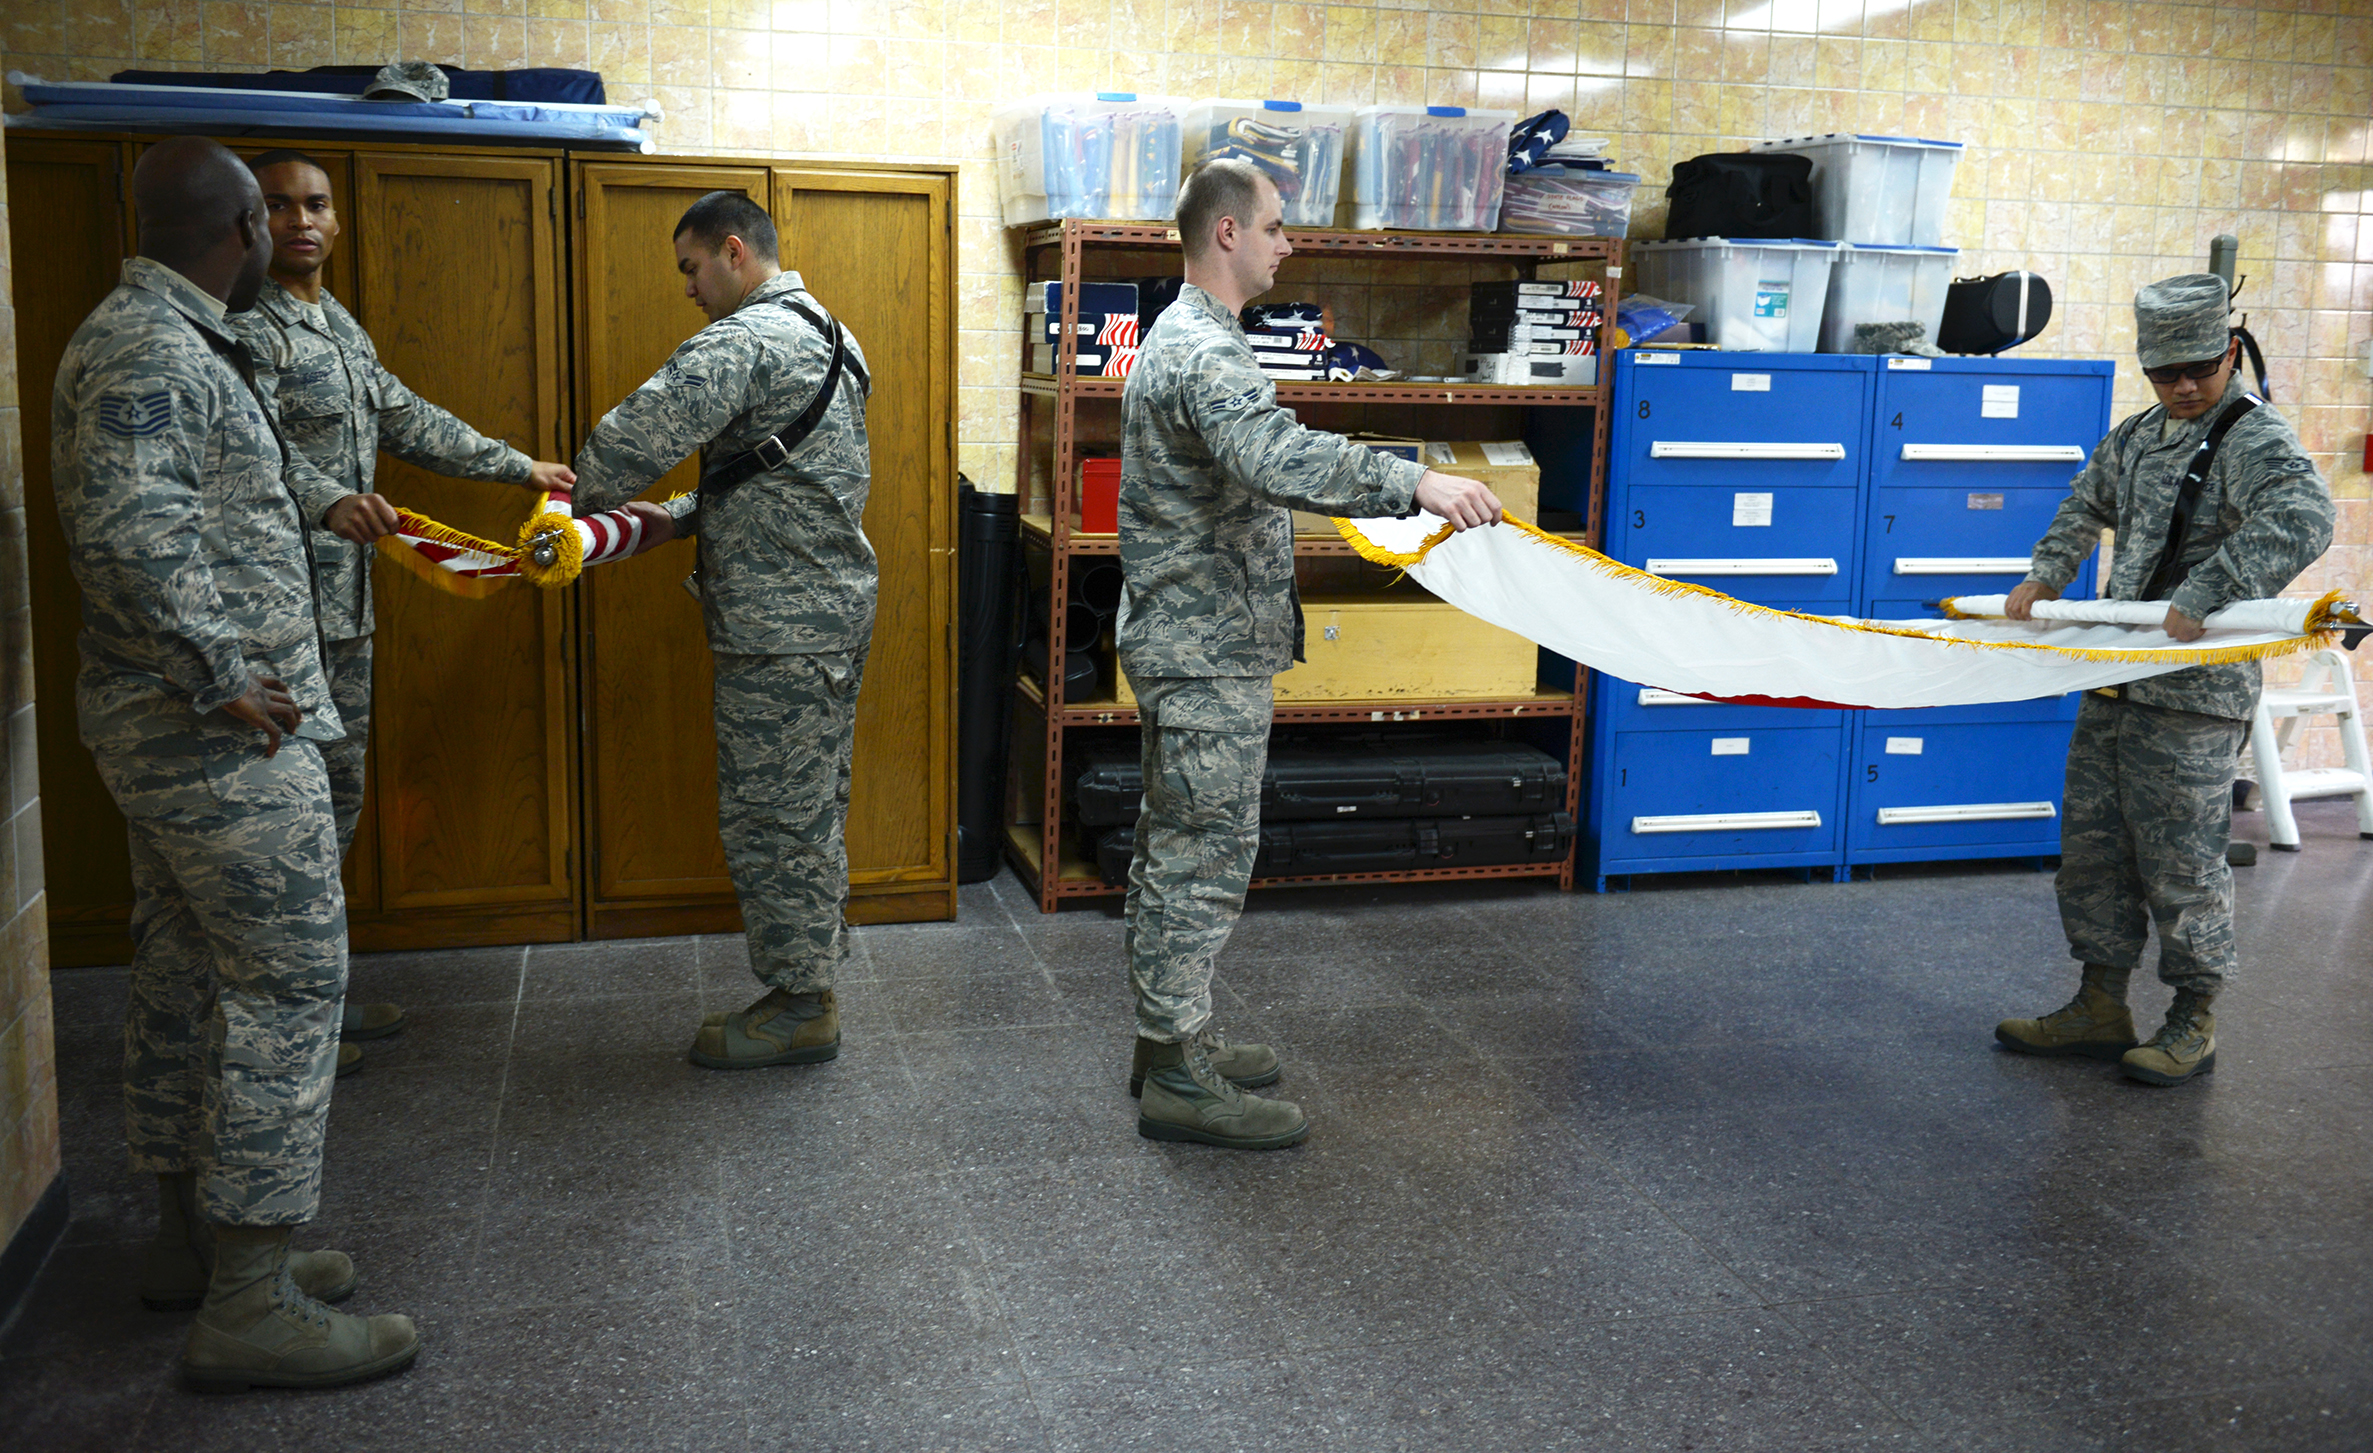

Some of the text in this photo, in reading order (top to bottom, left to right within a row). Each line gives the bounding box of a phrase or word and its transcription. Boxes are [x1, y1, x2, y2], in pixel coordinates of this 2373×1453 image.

[1638, 400, 1651, 419] 8
[1891, 411, 1903, 430] 4
[1633, 510, 1645, 529] 3
[1883, 515, 1895, 534] 7
[1621, 768, 1627, 787] 1
[1867, 764, 1878, 783] 5
